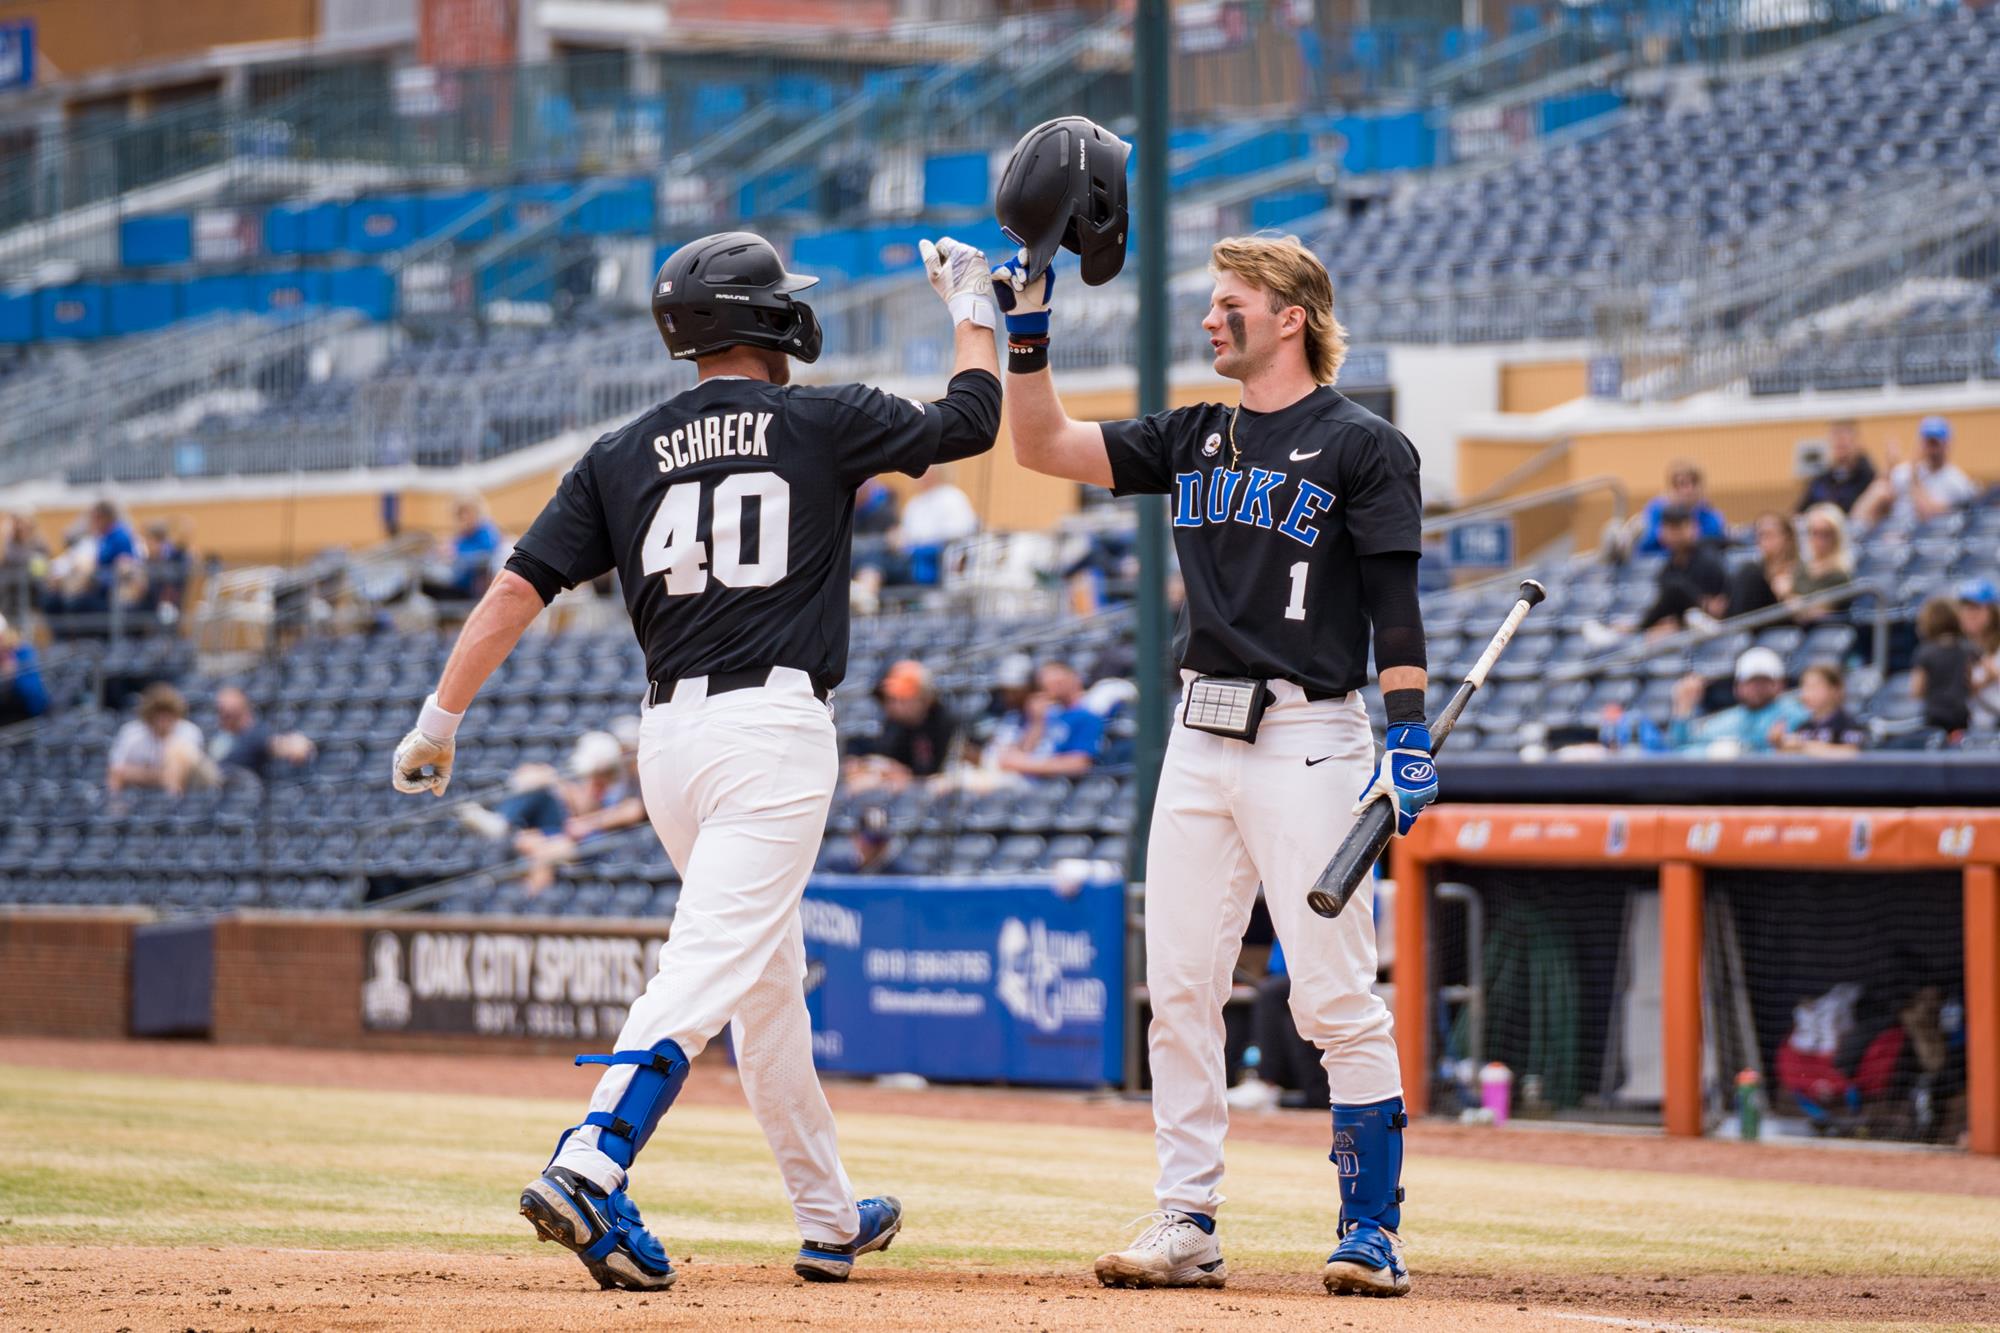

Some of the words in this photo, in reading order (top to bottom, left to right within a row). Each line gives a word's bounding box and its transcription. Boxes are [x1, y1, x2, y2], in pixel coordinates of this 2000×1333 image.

[653, 411, 774, 473] SCHRECK
[641, 471, 790, 596] 40
[1173, 466, 1336, 547] DUKE
[1284, 561, 1309, 621] 1
[411, 932, 472, 998] OAK
[472, 932, 534, 1001] CITY
[534, 935, 642, 1003] SPORTS
